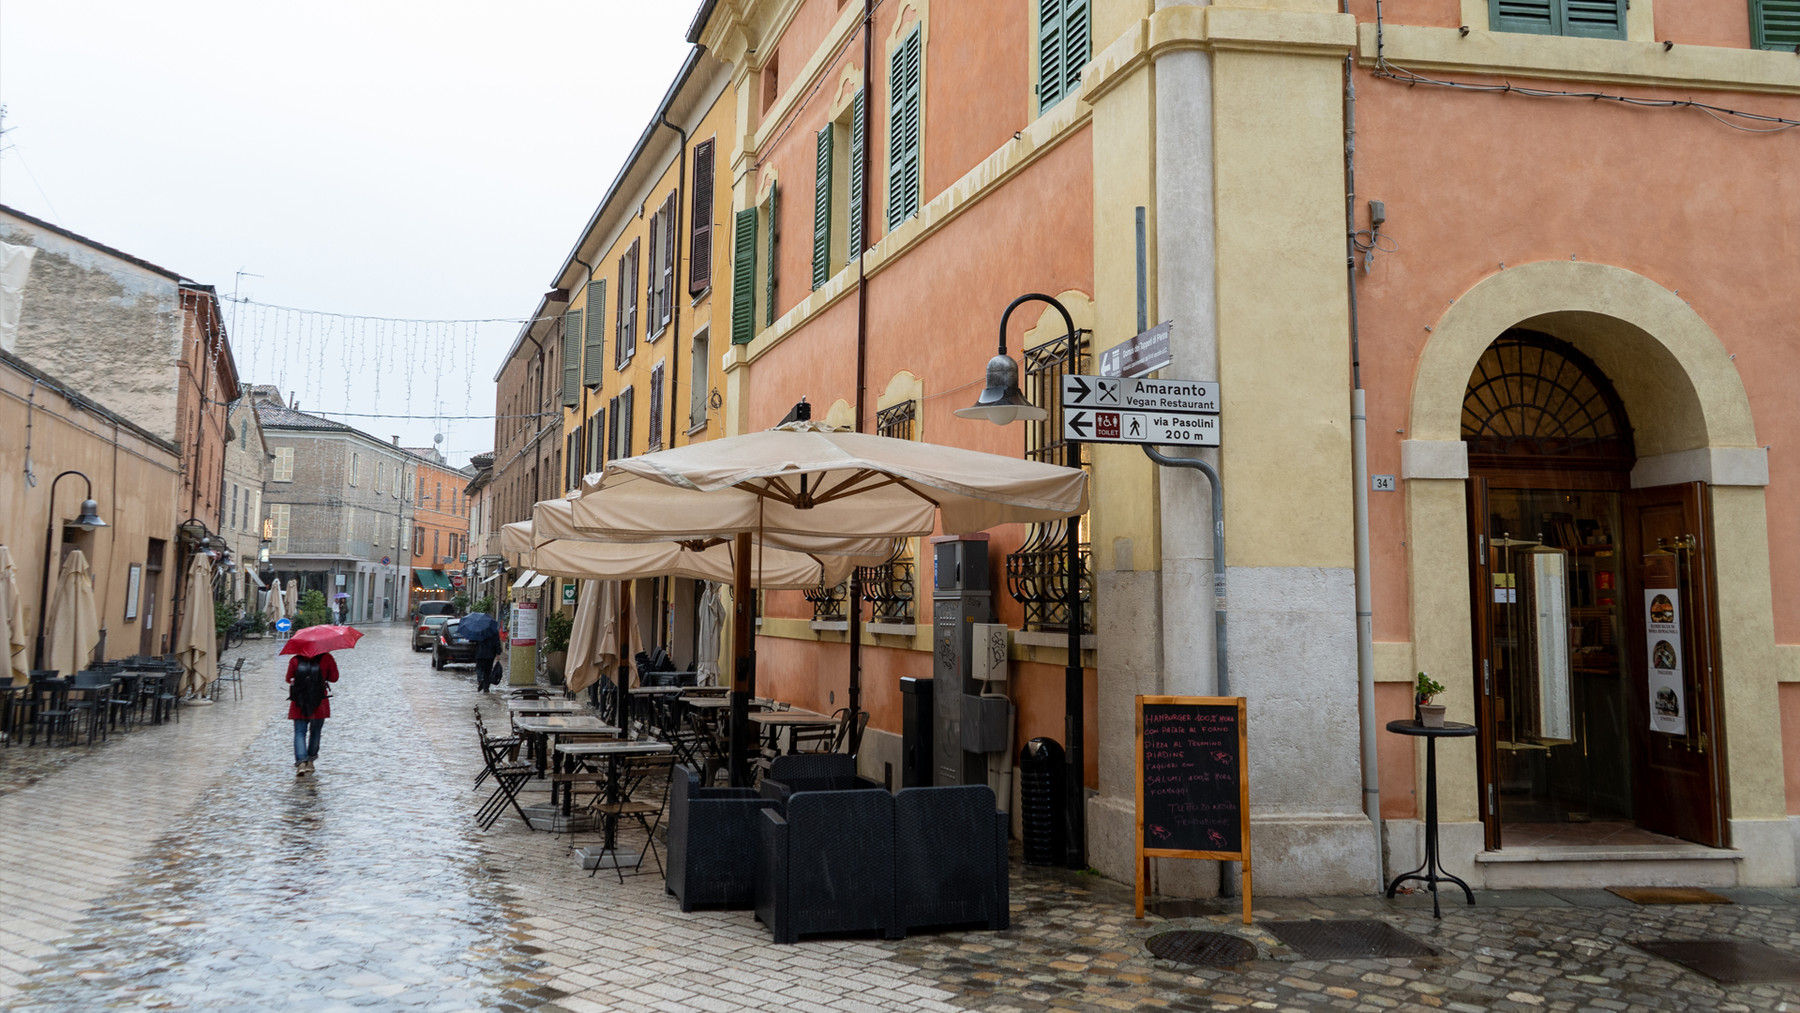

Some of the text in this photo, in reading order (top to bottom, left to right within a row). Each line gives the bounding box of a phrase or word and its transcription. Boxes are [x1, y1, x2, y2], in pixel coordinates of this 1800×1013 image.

[1134, 381, 1206, 396] Amaranto
[1126, 396, 1214, 409] Vegan Restaurant
[1154, 418, 1214, 428] via Pasolini
[1166, 430, 1190, 440] 200
[1377, 478, 1388, 488] 34
[1146, 714, 1191, 725] HAMBURGER
[1146, 752, 1184, 760] PIADINE
